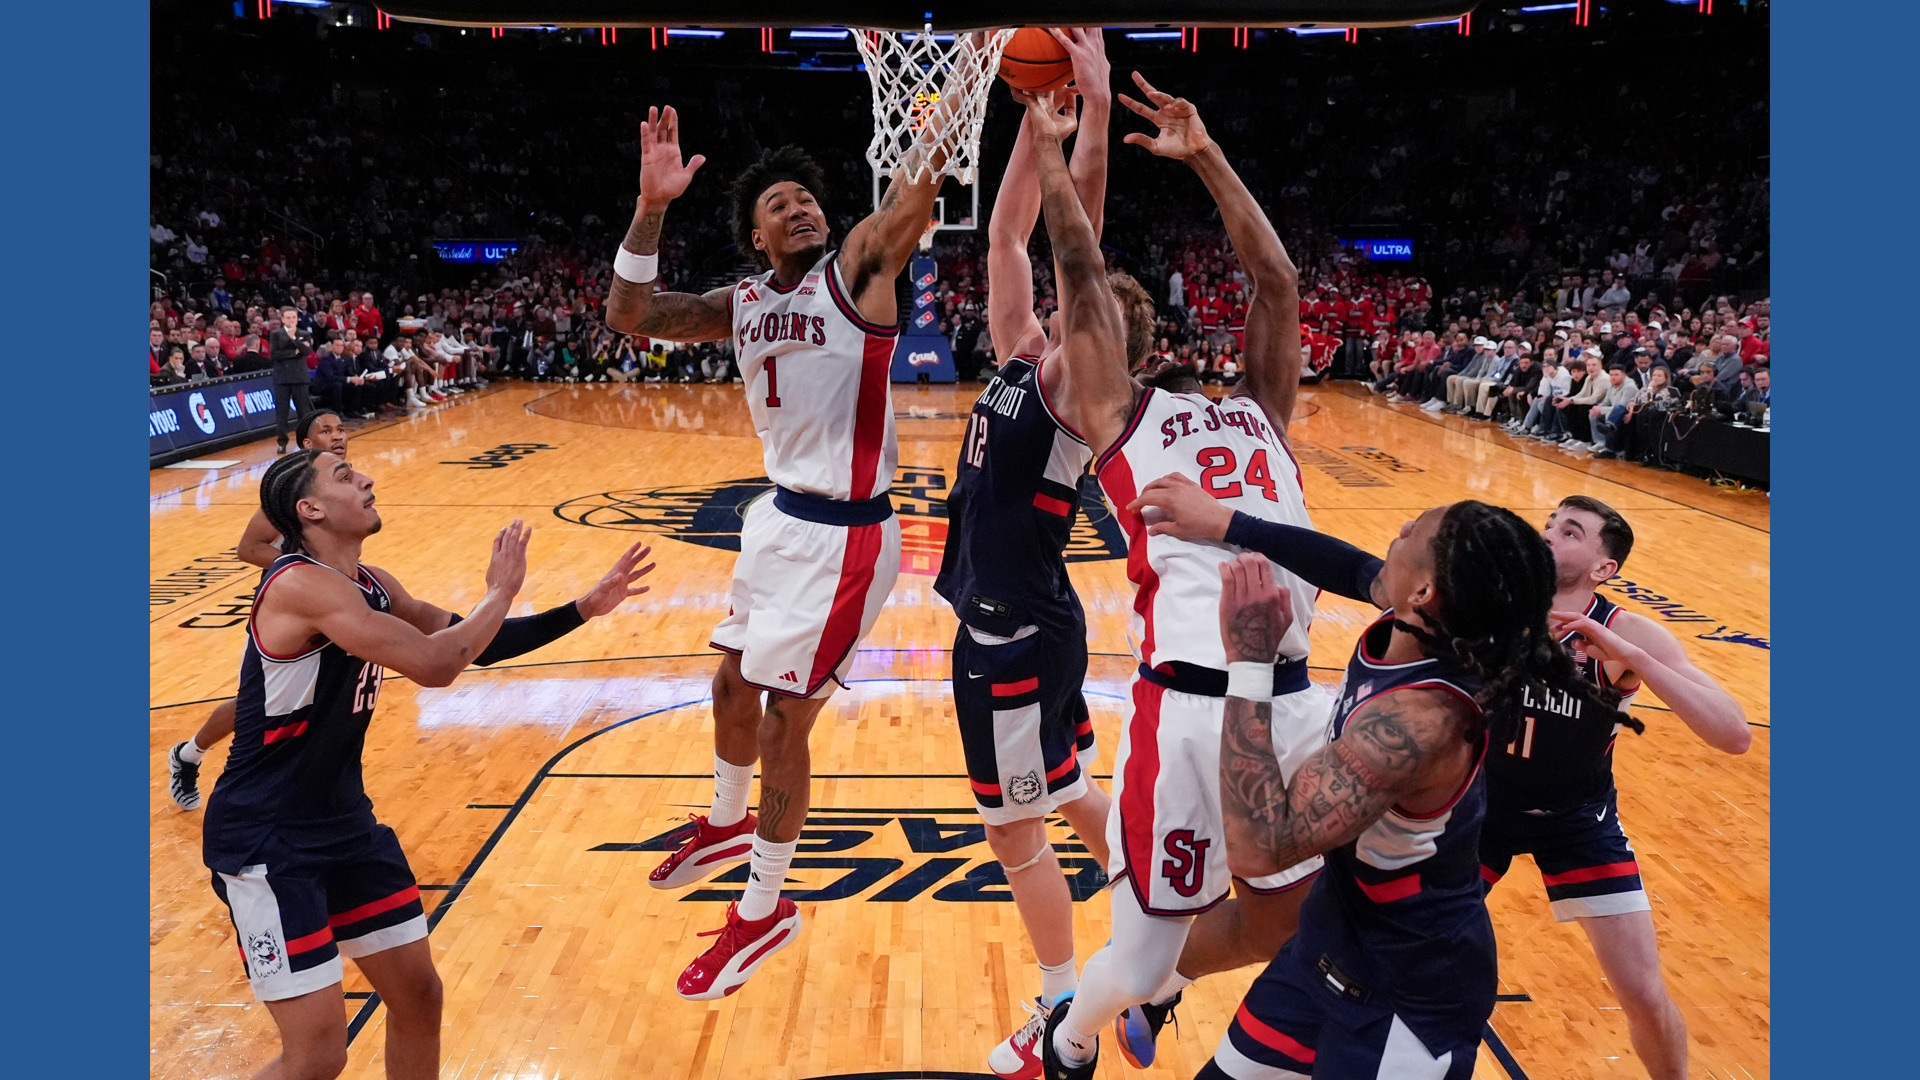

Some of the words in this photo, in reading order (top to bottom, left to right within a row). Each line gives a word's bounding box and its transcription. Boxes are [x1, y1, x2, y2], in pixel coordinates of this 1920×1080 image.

[1373, 245, 1411, 255] ULTRA
[750, 312, 826, 346] JOHN'S
[908, 351, 940, 366] Crush
[253, 389, 276, 412] YOU?
[763, 356, 781, 408] 1
[967, 412, 989, 469] 12
[1161, 412, 1199, 450] ST.
[438, 443, 558, 470] Jeep
[1196, 446, 1279, 503] 24
[352, 661, 384, 714] 23
[678, 857, 1109, 902] BIG
